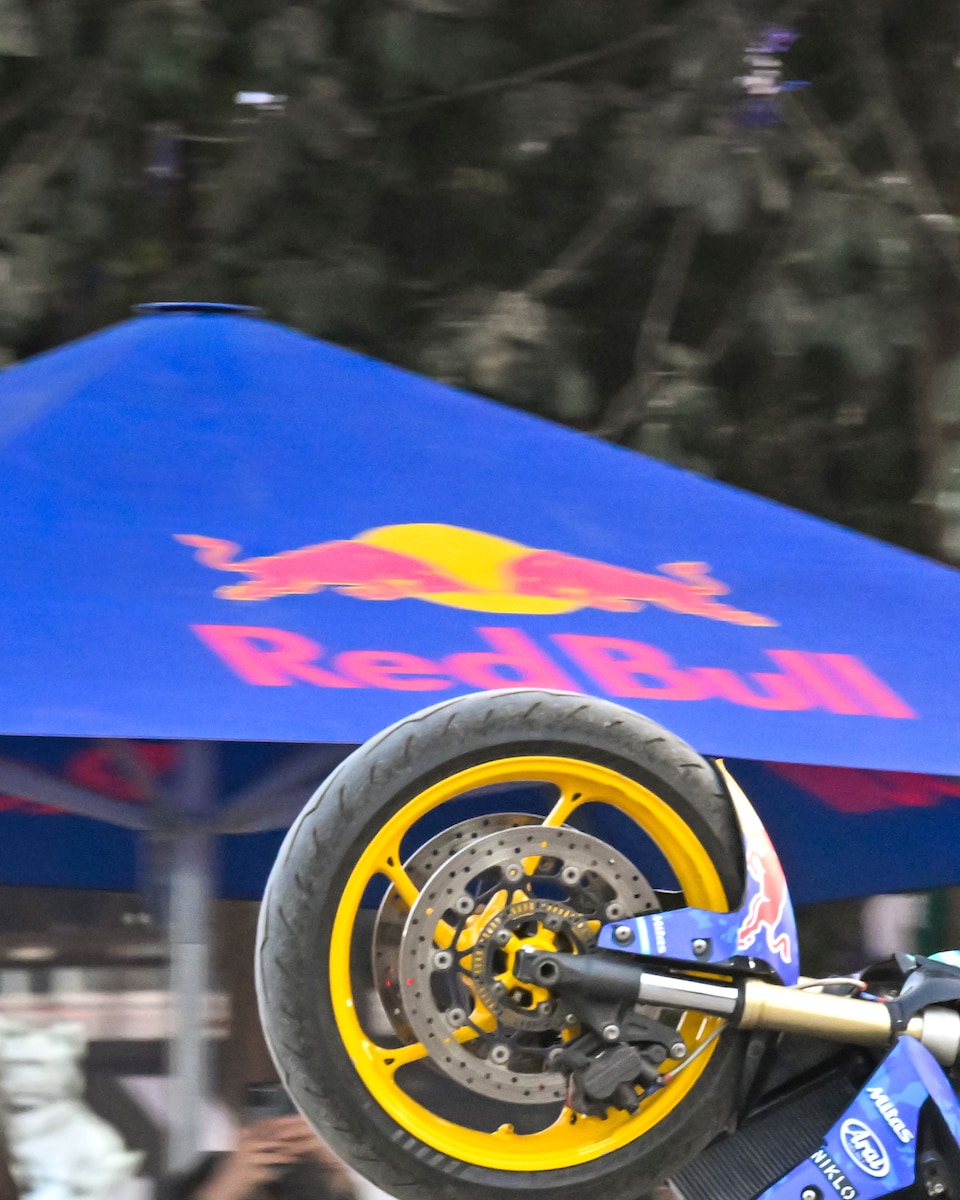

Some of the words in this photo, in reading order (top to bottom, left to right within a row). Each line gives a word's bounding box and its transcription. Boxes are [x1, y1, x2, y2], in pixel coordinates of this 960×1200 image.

[190, 624, 584, 692] Red
[550, 633, 918, 719] Bull
[866, 1087, 914, 1143] Mitas
[811, 1148, 856, 1200] NIKLO
[846, 1128, 886, 1170] Arai
